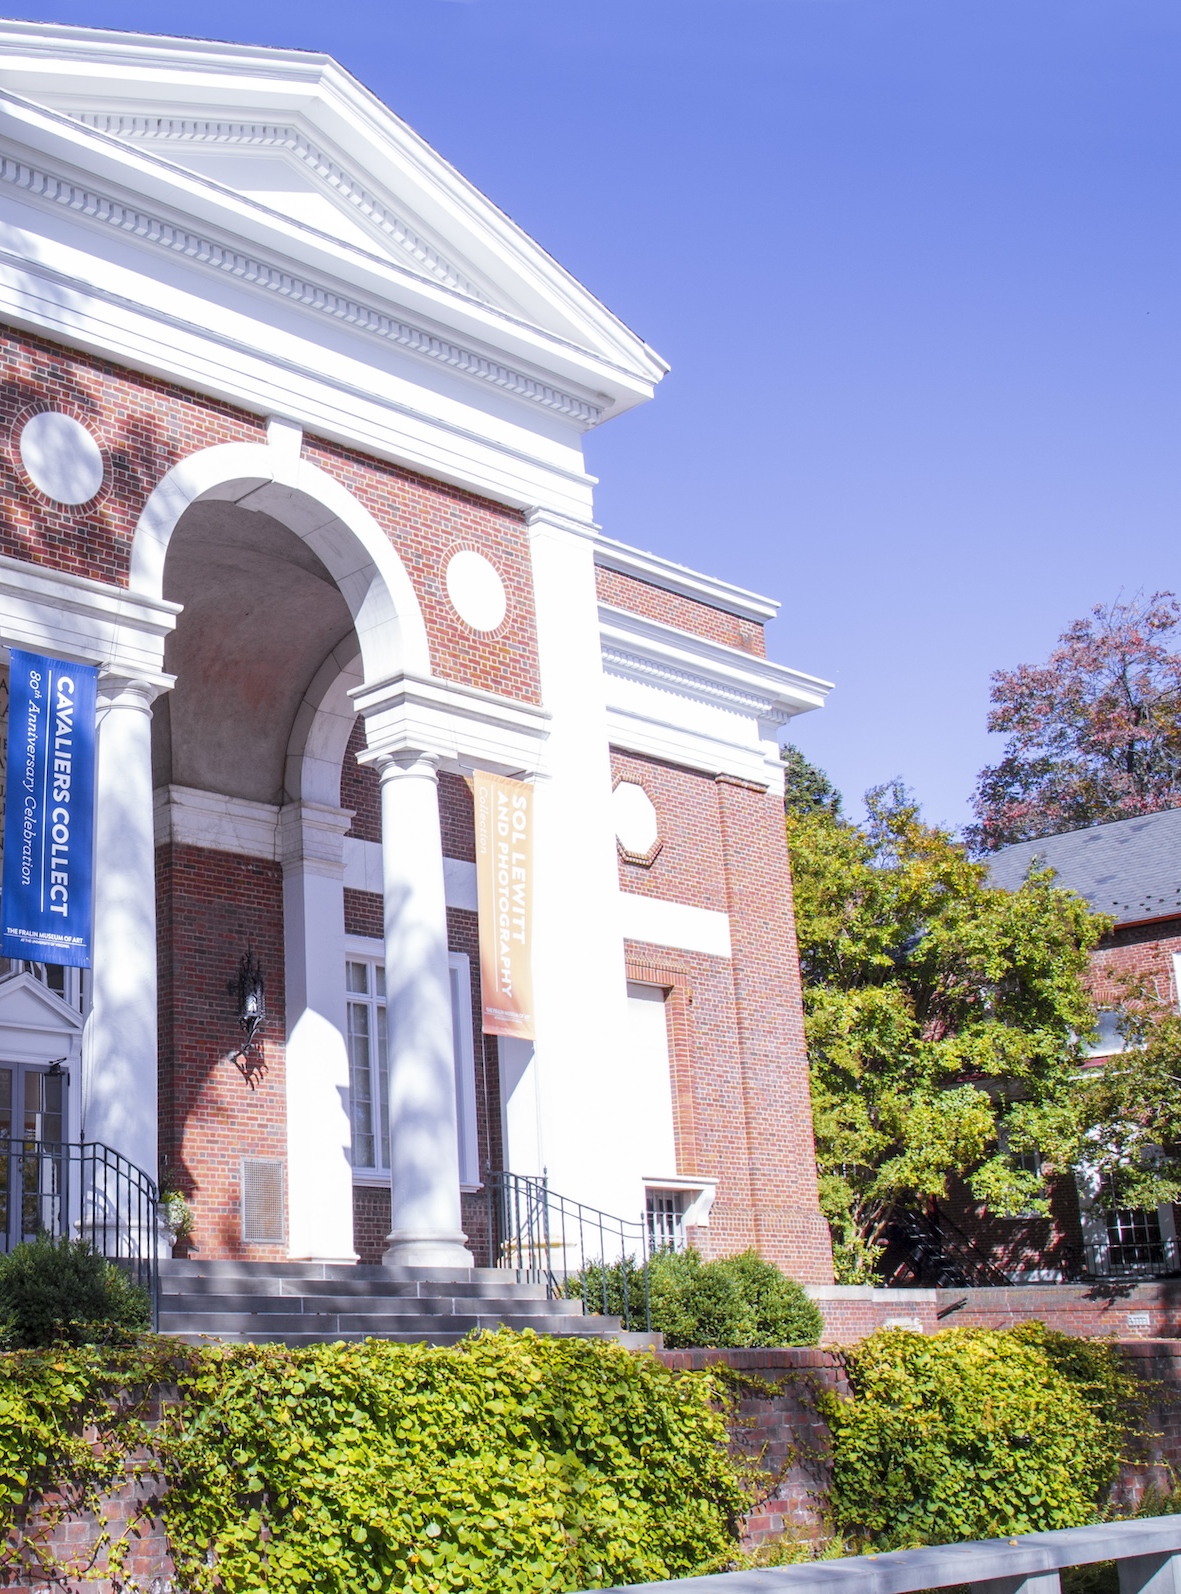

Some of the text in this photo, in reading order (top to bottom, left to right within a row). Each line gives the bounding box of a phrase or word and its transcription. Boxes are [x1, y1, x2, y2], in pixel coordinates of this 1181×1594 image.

[21, 670, 43, 885] 80th Anniversary Celebration
[50, 676, 75, 917] CAVALIERS COLLECT
[479, 786, 489, 854] Collection
[6, 927, 18, 935] THE
[18, 929, 39, 938] FRALIN
[39, 932, 64, 941] MUSEUM
[497, 790, 512, 998] AND PHOTOGRAPHY
[511, 794, 527, 945] SOL LEWITT
